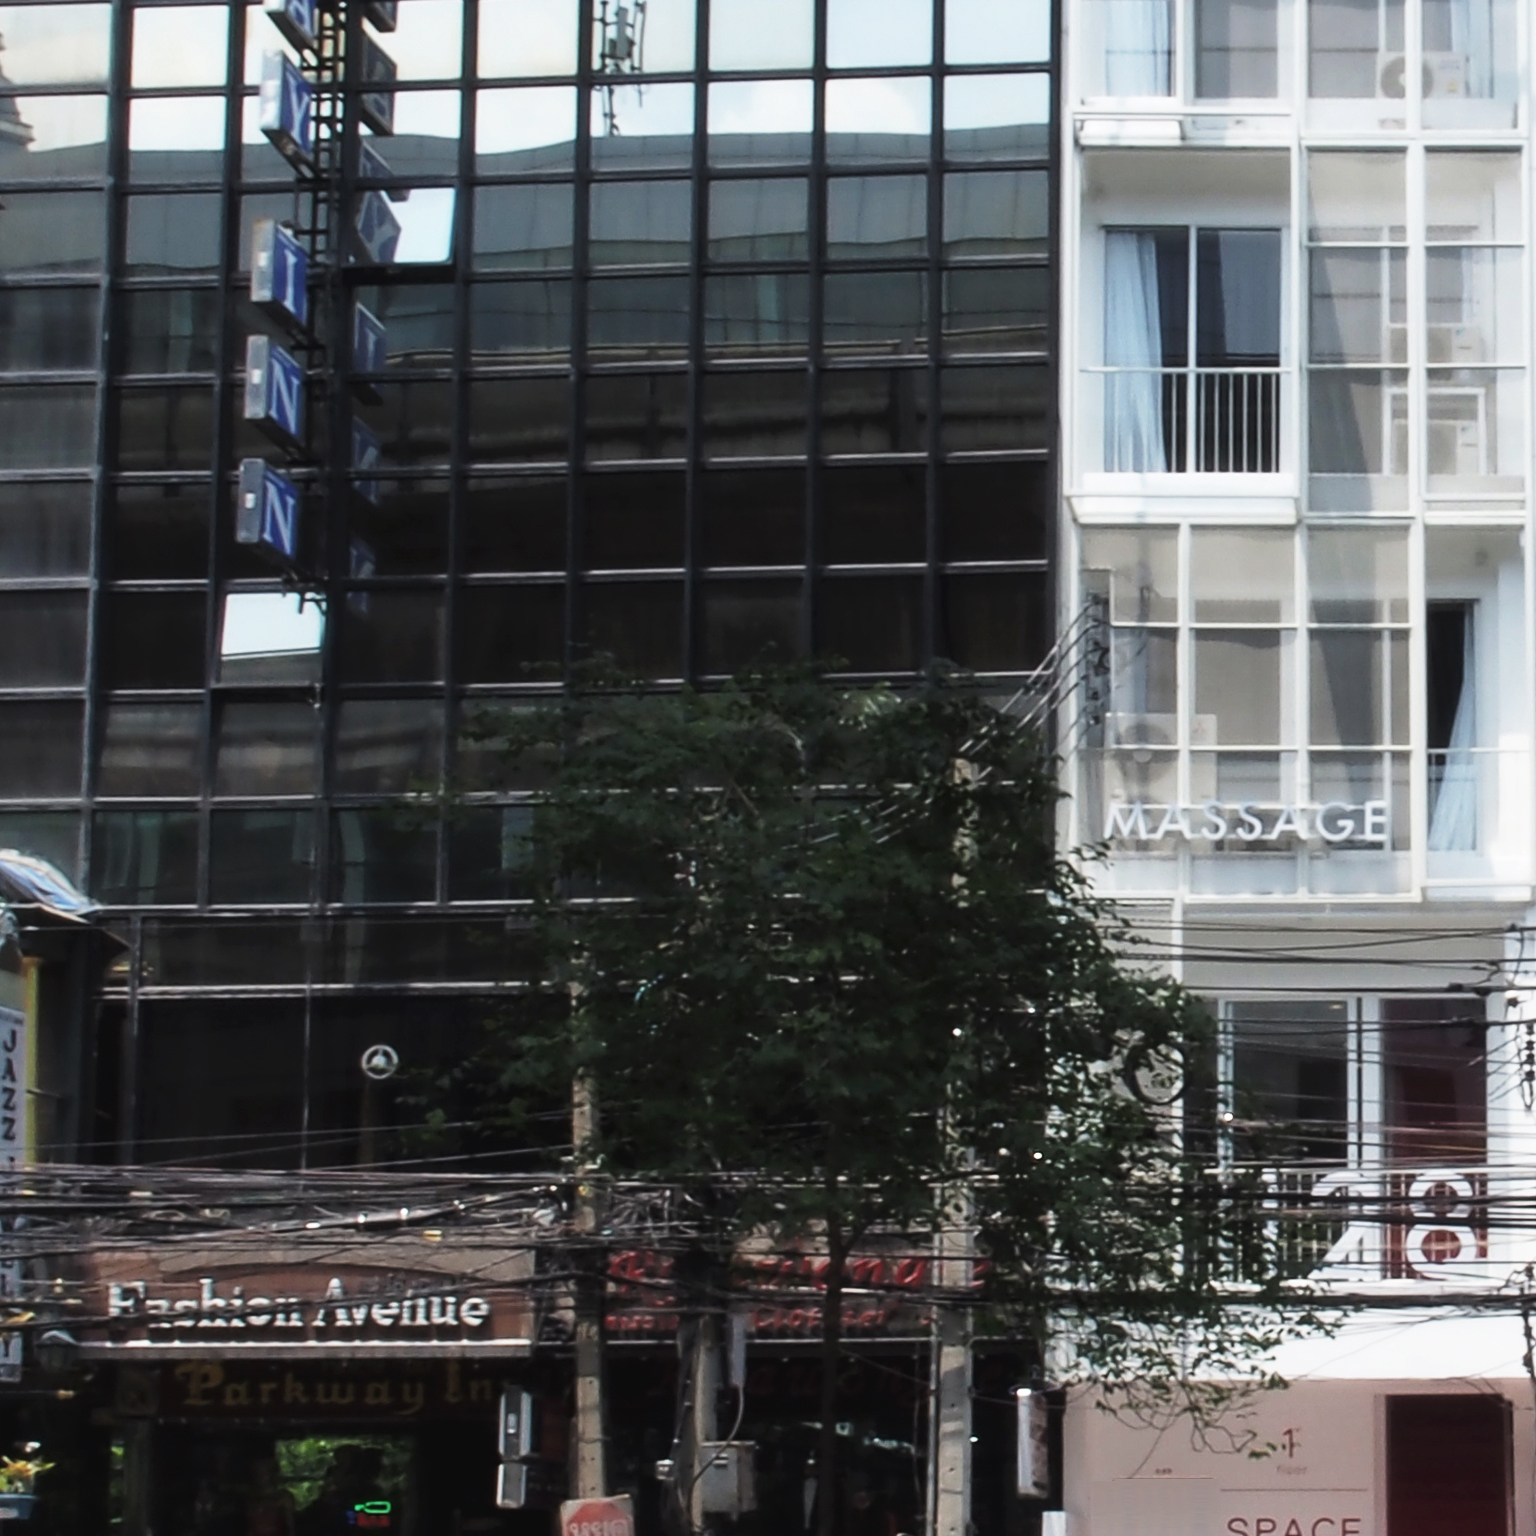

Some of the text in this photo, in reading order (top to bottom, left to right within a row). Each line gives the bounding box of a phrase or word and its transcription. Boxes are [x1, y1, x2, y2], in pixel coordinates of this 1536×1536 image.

[263, 249, 300, 556] INN
[1103, 800, 1388, 842] MASSAGE
[2, 1028, 17, 1141] JAZZ
[108, 1277, 490, 1327] Fashion Avenue
[175, 1358, 426, 1413] Parkway
